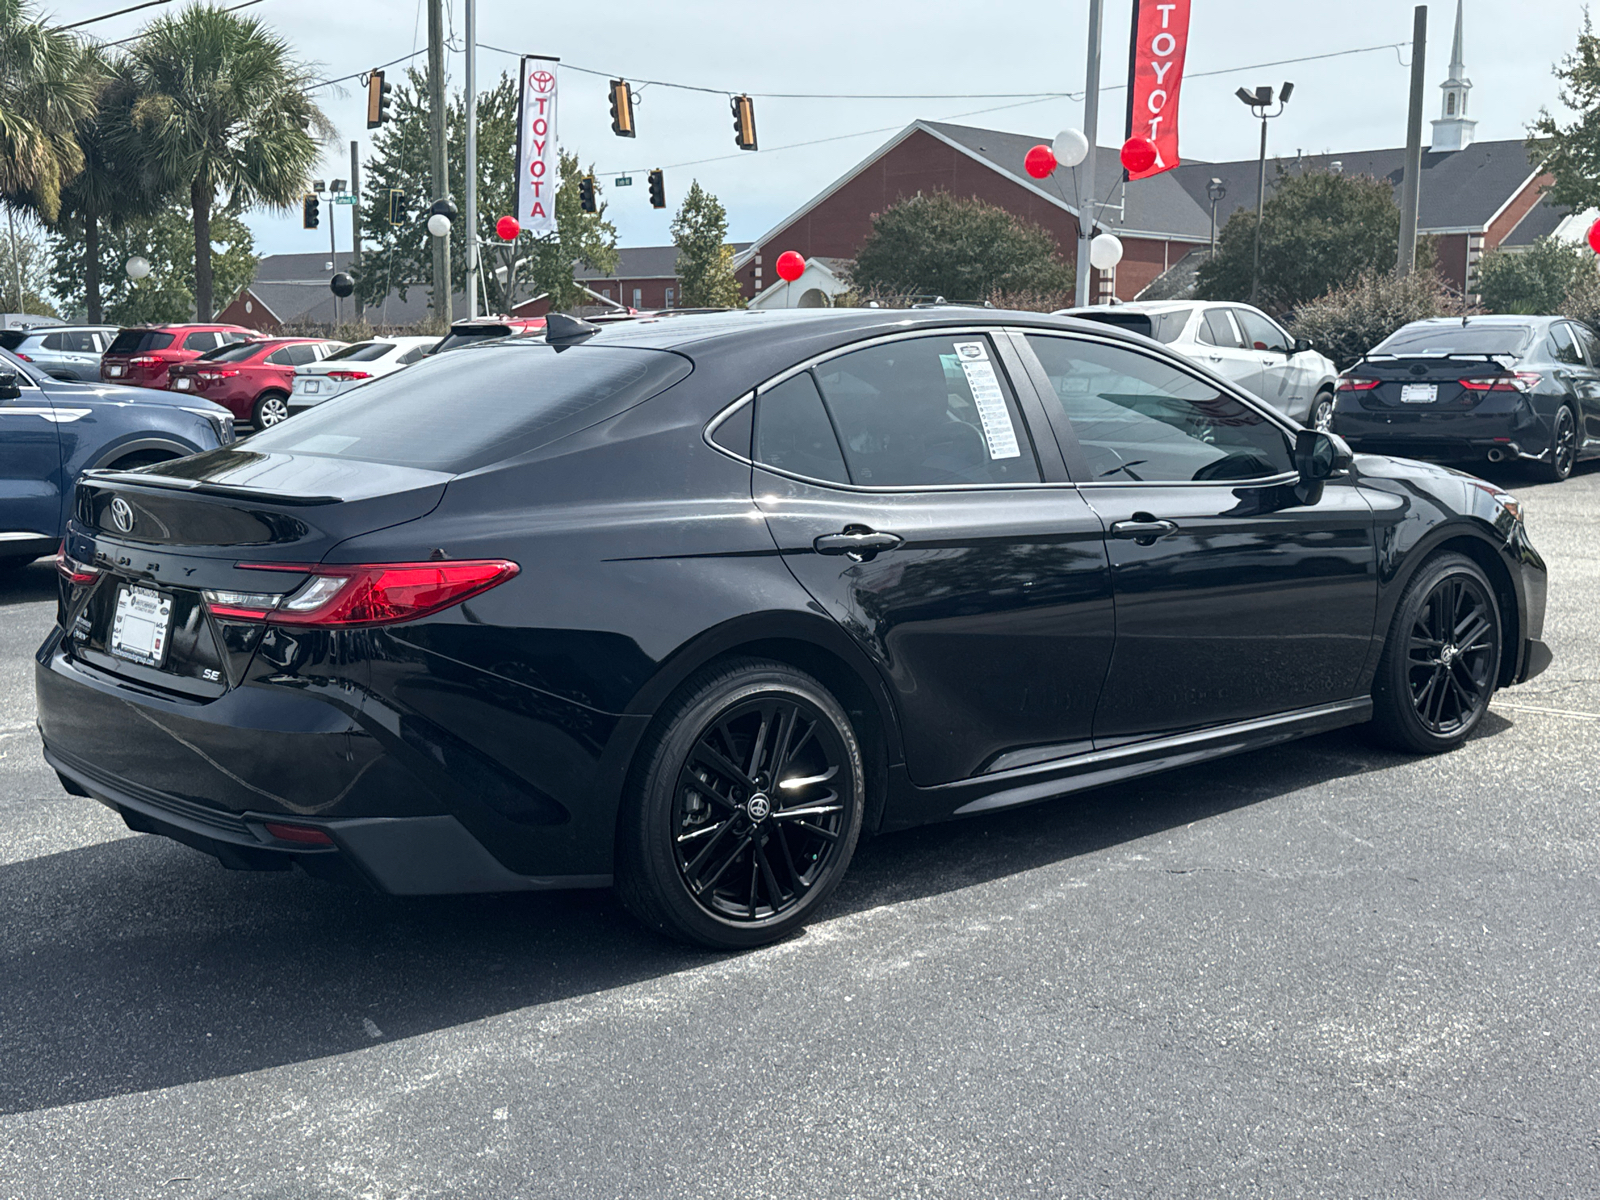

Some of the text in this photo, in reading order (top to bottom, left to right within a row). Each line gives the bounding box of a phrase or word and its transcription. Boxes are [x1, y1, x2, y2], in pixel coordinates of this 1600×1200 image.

[530, 98, 548, 218] TOYOTA
[202, 668, 220, 681] SE
[831, 709, 863, 794] URANZA
